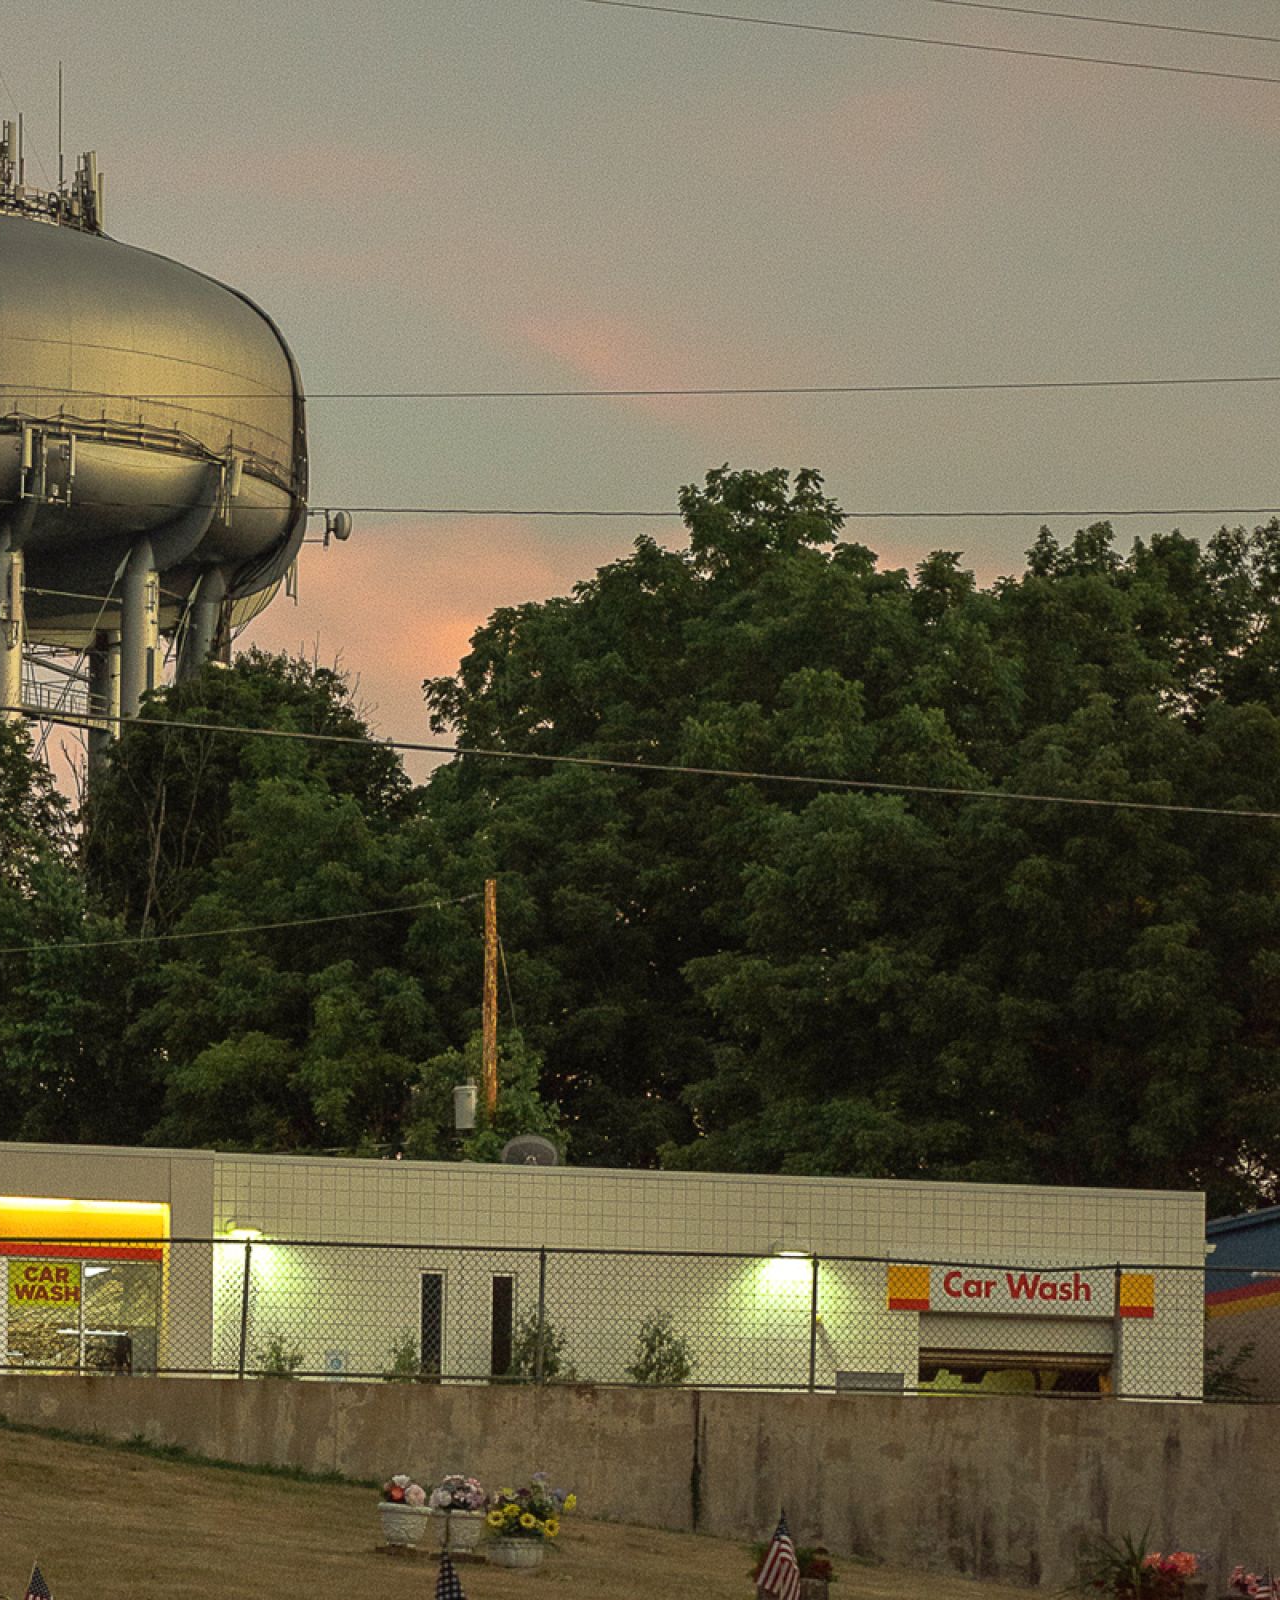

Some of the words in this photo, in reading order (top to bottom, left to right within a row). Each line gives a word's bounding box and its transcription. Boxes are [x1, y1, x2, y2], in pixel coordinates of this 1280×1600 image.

[24, 1266, 69, 1282] CAR
[15, 1284, 81, 1301] WASH
[943, 1271, 997, 1298] Car
[1006, 1273, 1091, 1301] Wash
